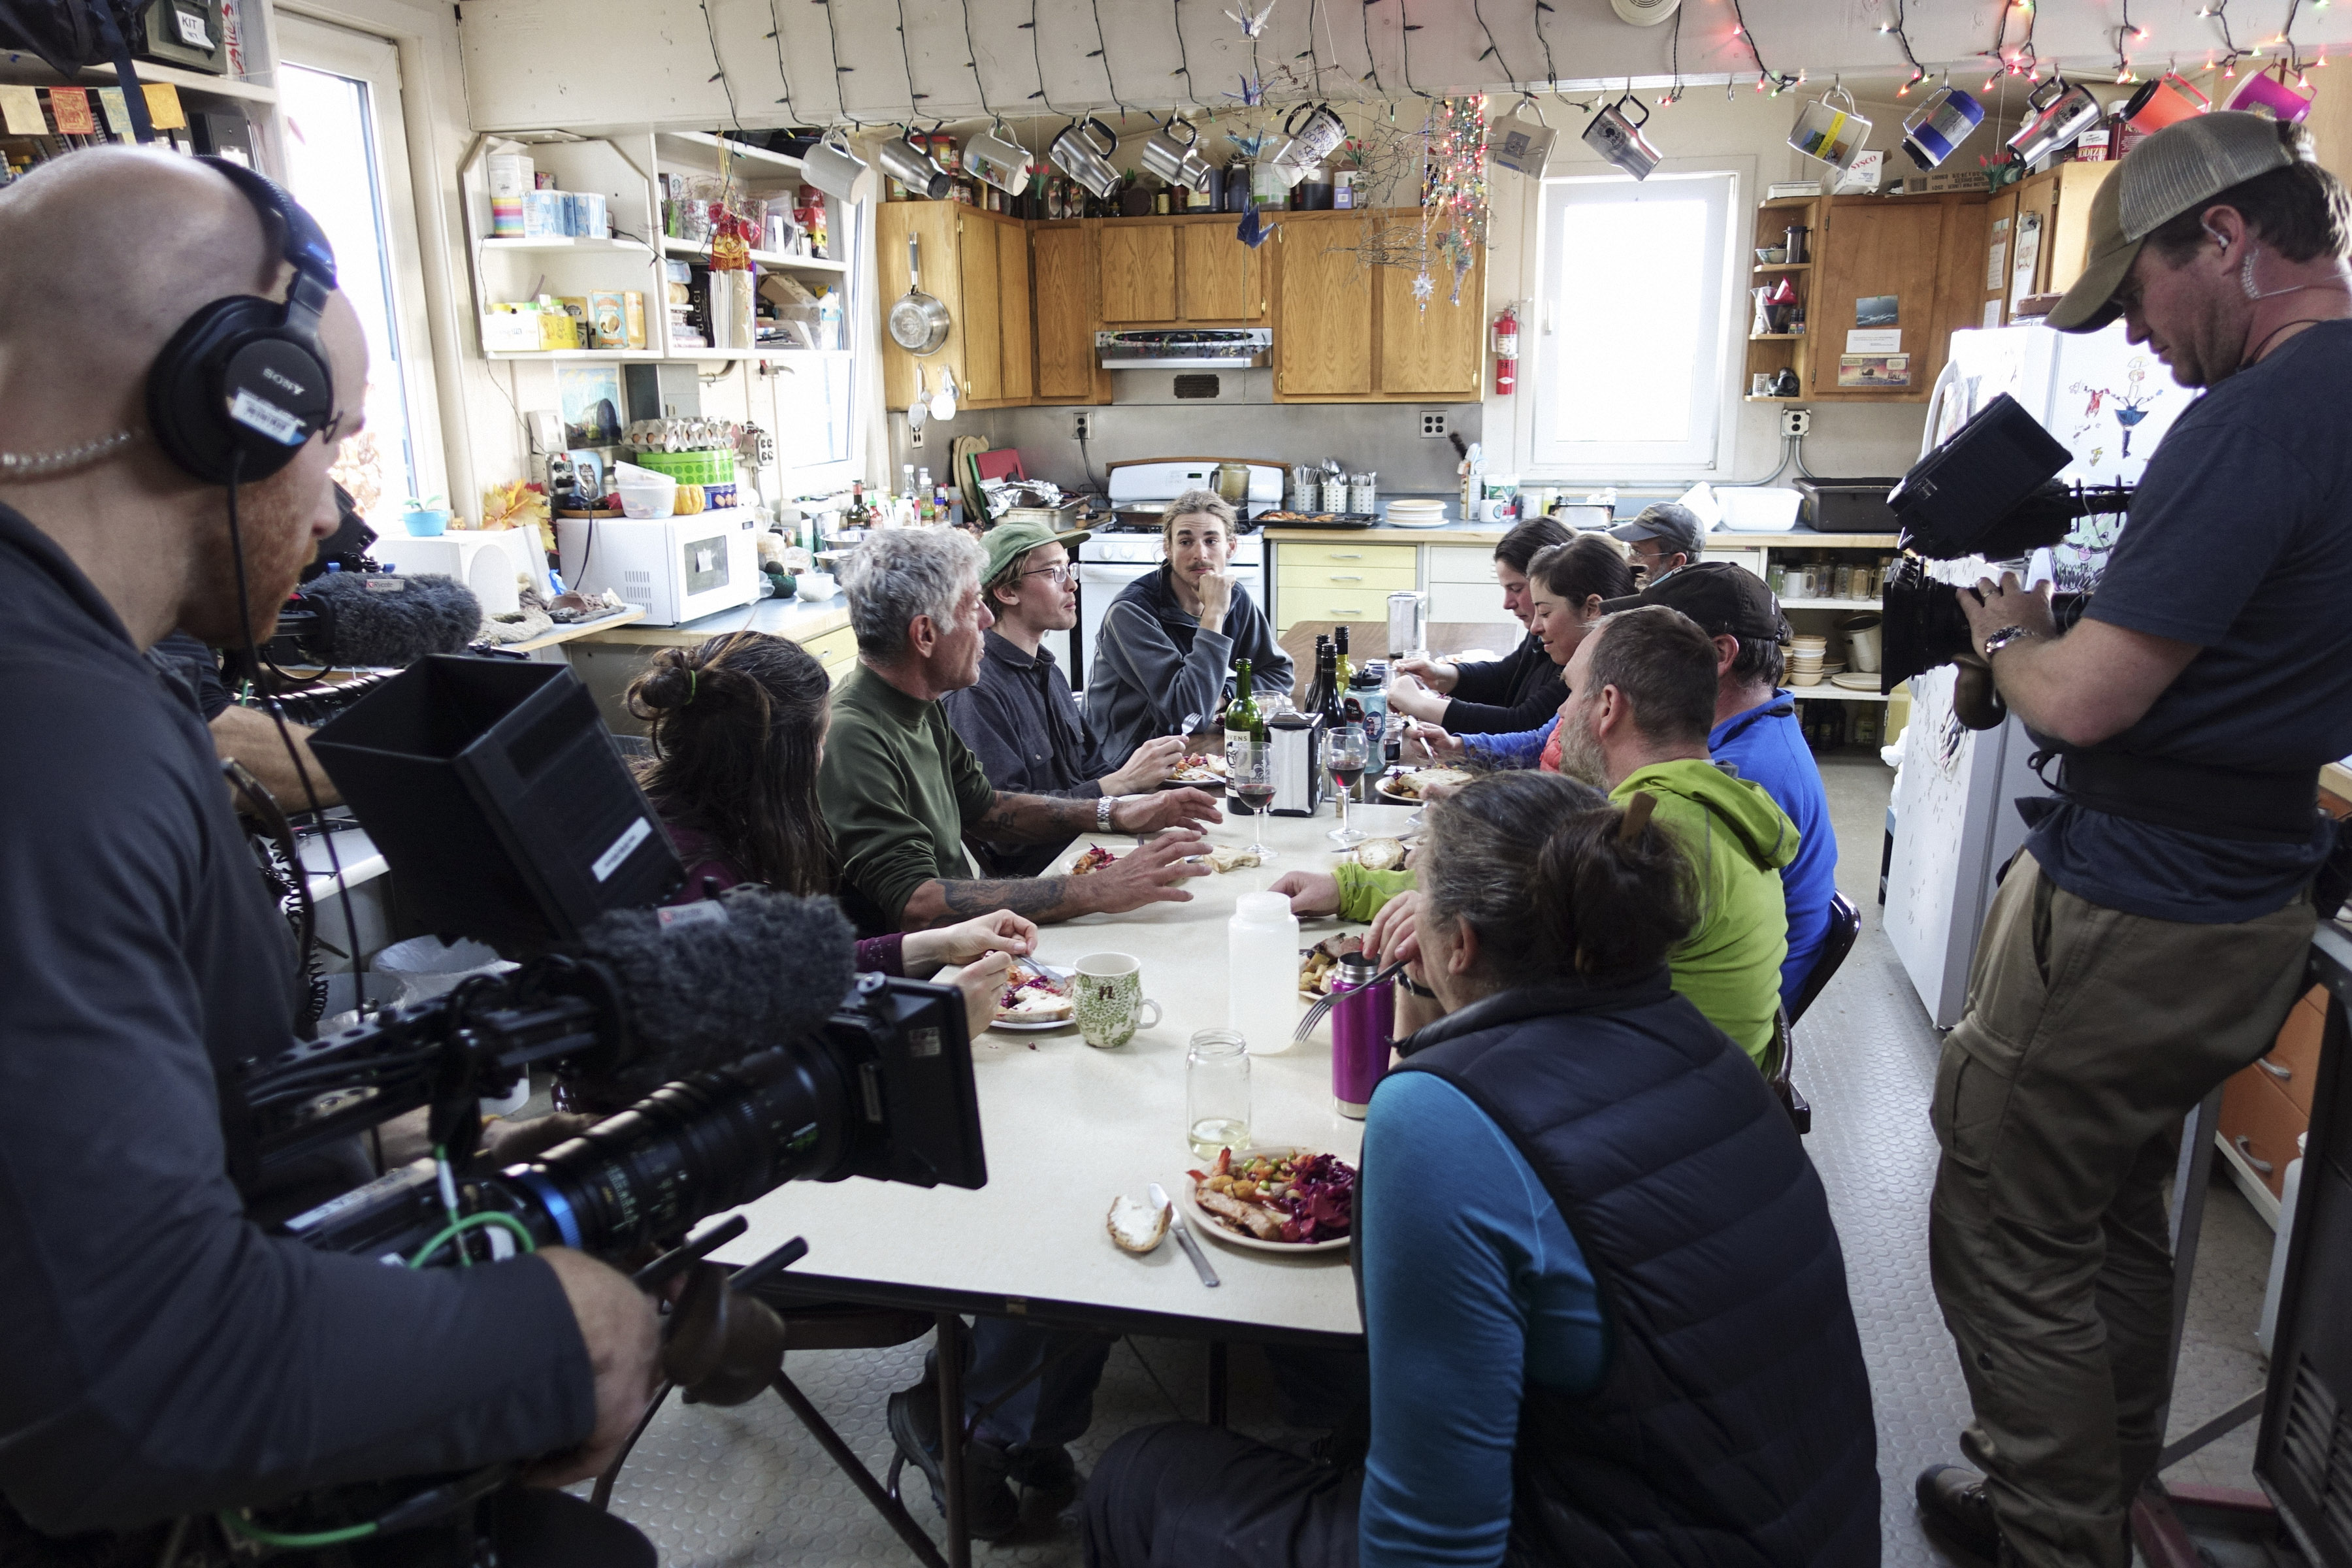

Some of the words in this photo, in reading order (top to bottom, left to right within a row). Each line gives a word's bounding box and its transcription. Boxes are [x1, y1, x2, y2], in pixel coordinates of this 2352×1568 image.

[182, 16, 197, 29] KIT
[2078, 148, 2106, 158] IODIZED
[1850, 155, 1877, 170] SYSCO
[693, 290, 704, 331] GUCCI
[263, 368, 305, 395] SONY
